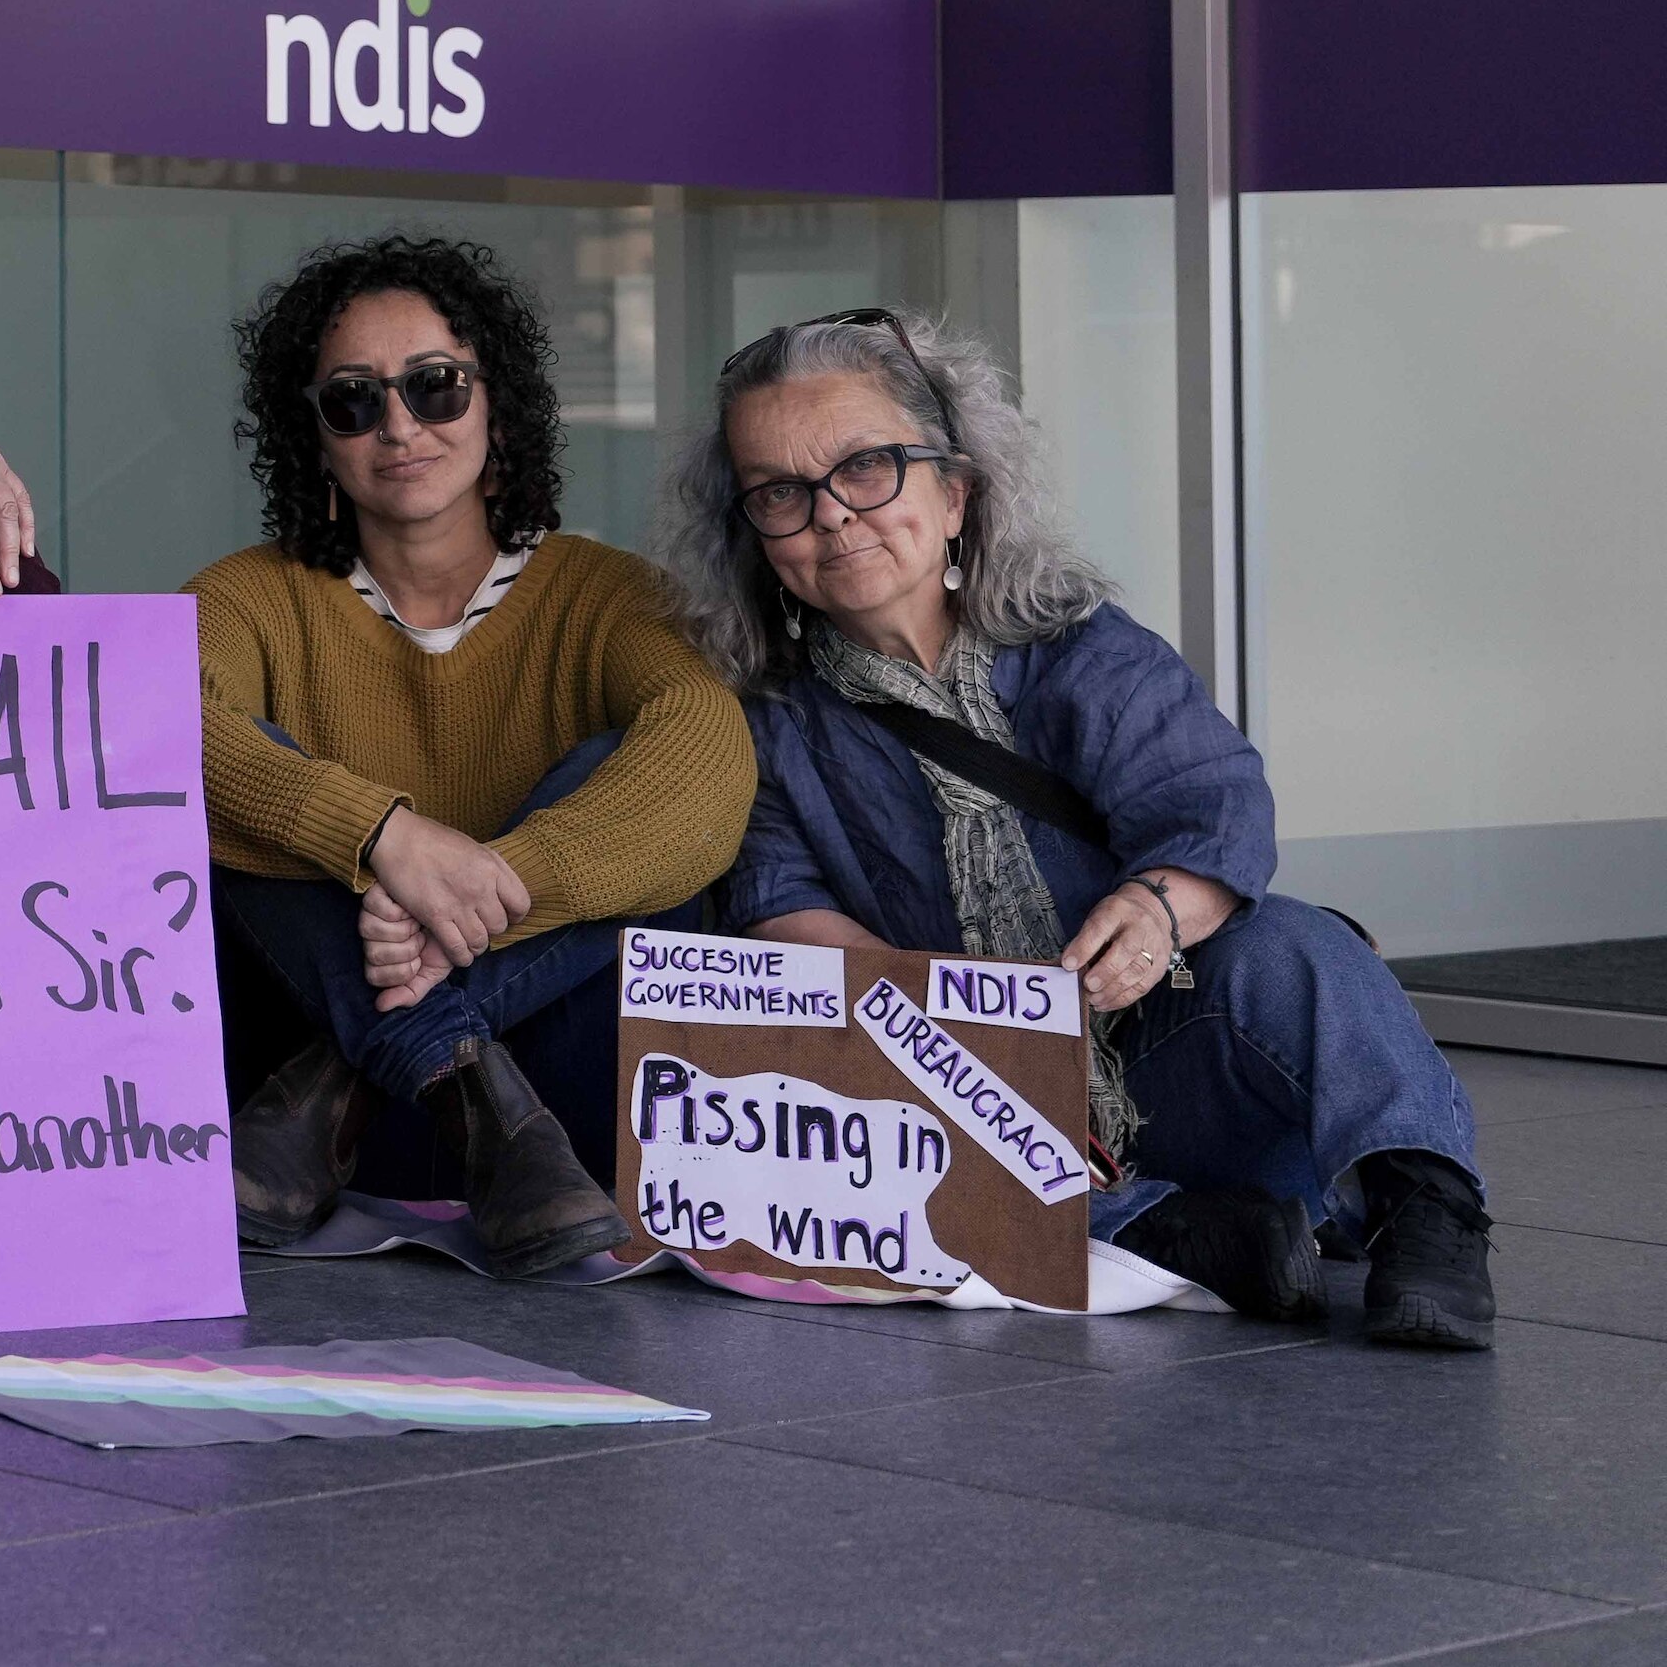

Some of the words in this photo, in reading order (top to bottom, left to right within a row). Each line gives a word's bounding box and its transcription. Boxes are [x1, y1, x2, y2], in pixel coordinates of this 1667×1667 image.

[20, 870, 198, 1014] Sir?
[628, 934, 785, 977] SUCCESIVE
[625, 977, 840, 1019] GOVERNMENTS
[939, 967, 1051, 1021] NDIS
[862, 980, 1085, 1195] BUREAUCRACY
[638, 1059, 872, 1189] Pissing
[897, 1108, 945, 1174] in
[641, 1179, 727, 1249] the
